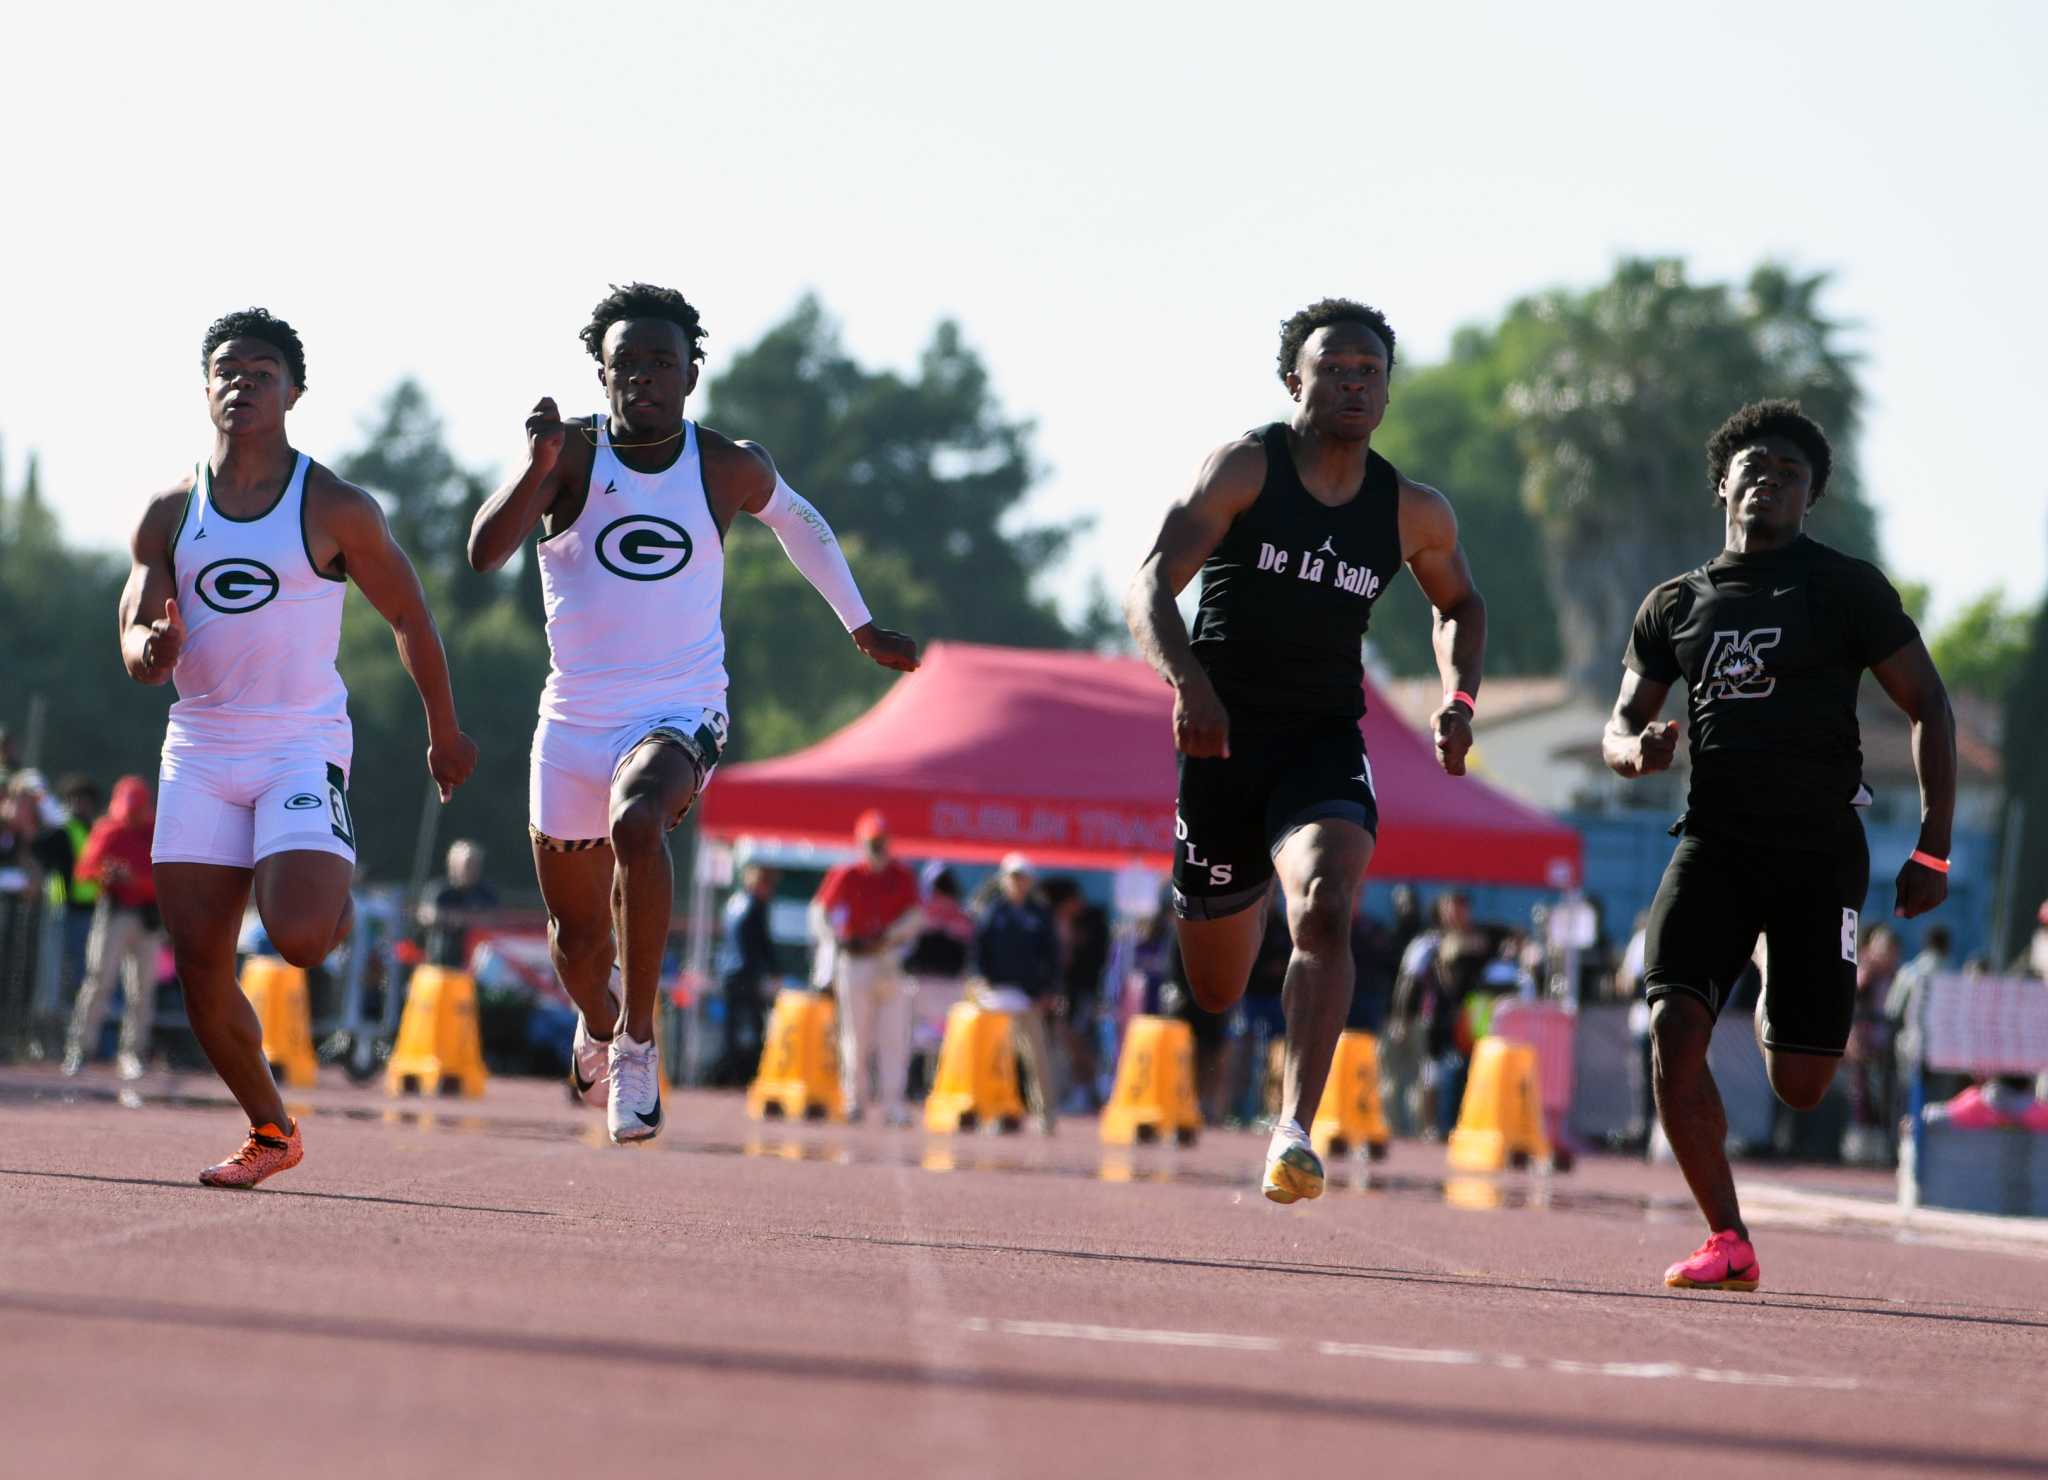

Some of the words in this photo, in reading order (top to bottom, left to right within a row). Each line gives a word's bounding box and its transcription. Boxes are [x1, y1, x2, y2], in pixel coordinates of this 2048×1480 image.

[595, 514, 693, 581] G
[1257, 542, 1289, 574] De
[1297, 551, 1325, 583] La
[1333, 561, 1380, 599] Salle
[195, 558, 280, 614] G
[329, 787, 345, 829] 6
[1078, 810, 1178, 850] TRAC
